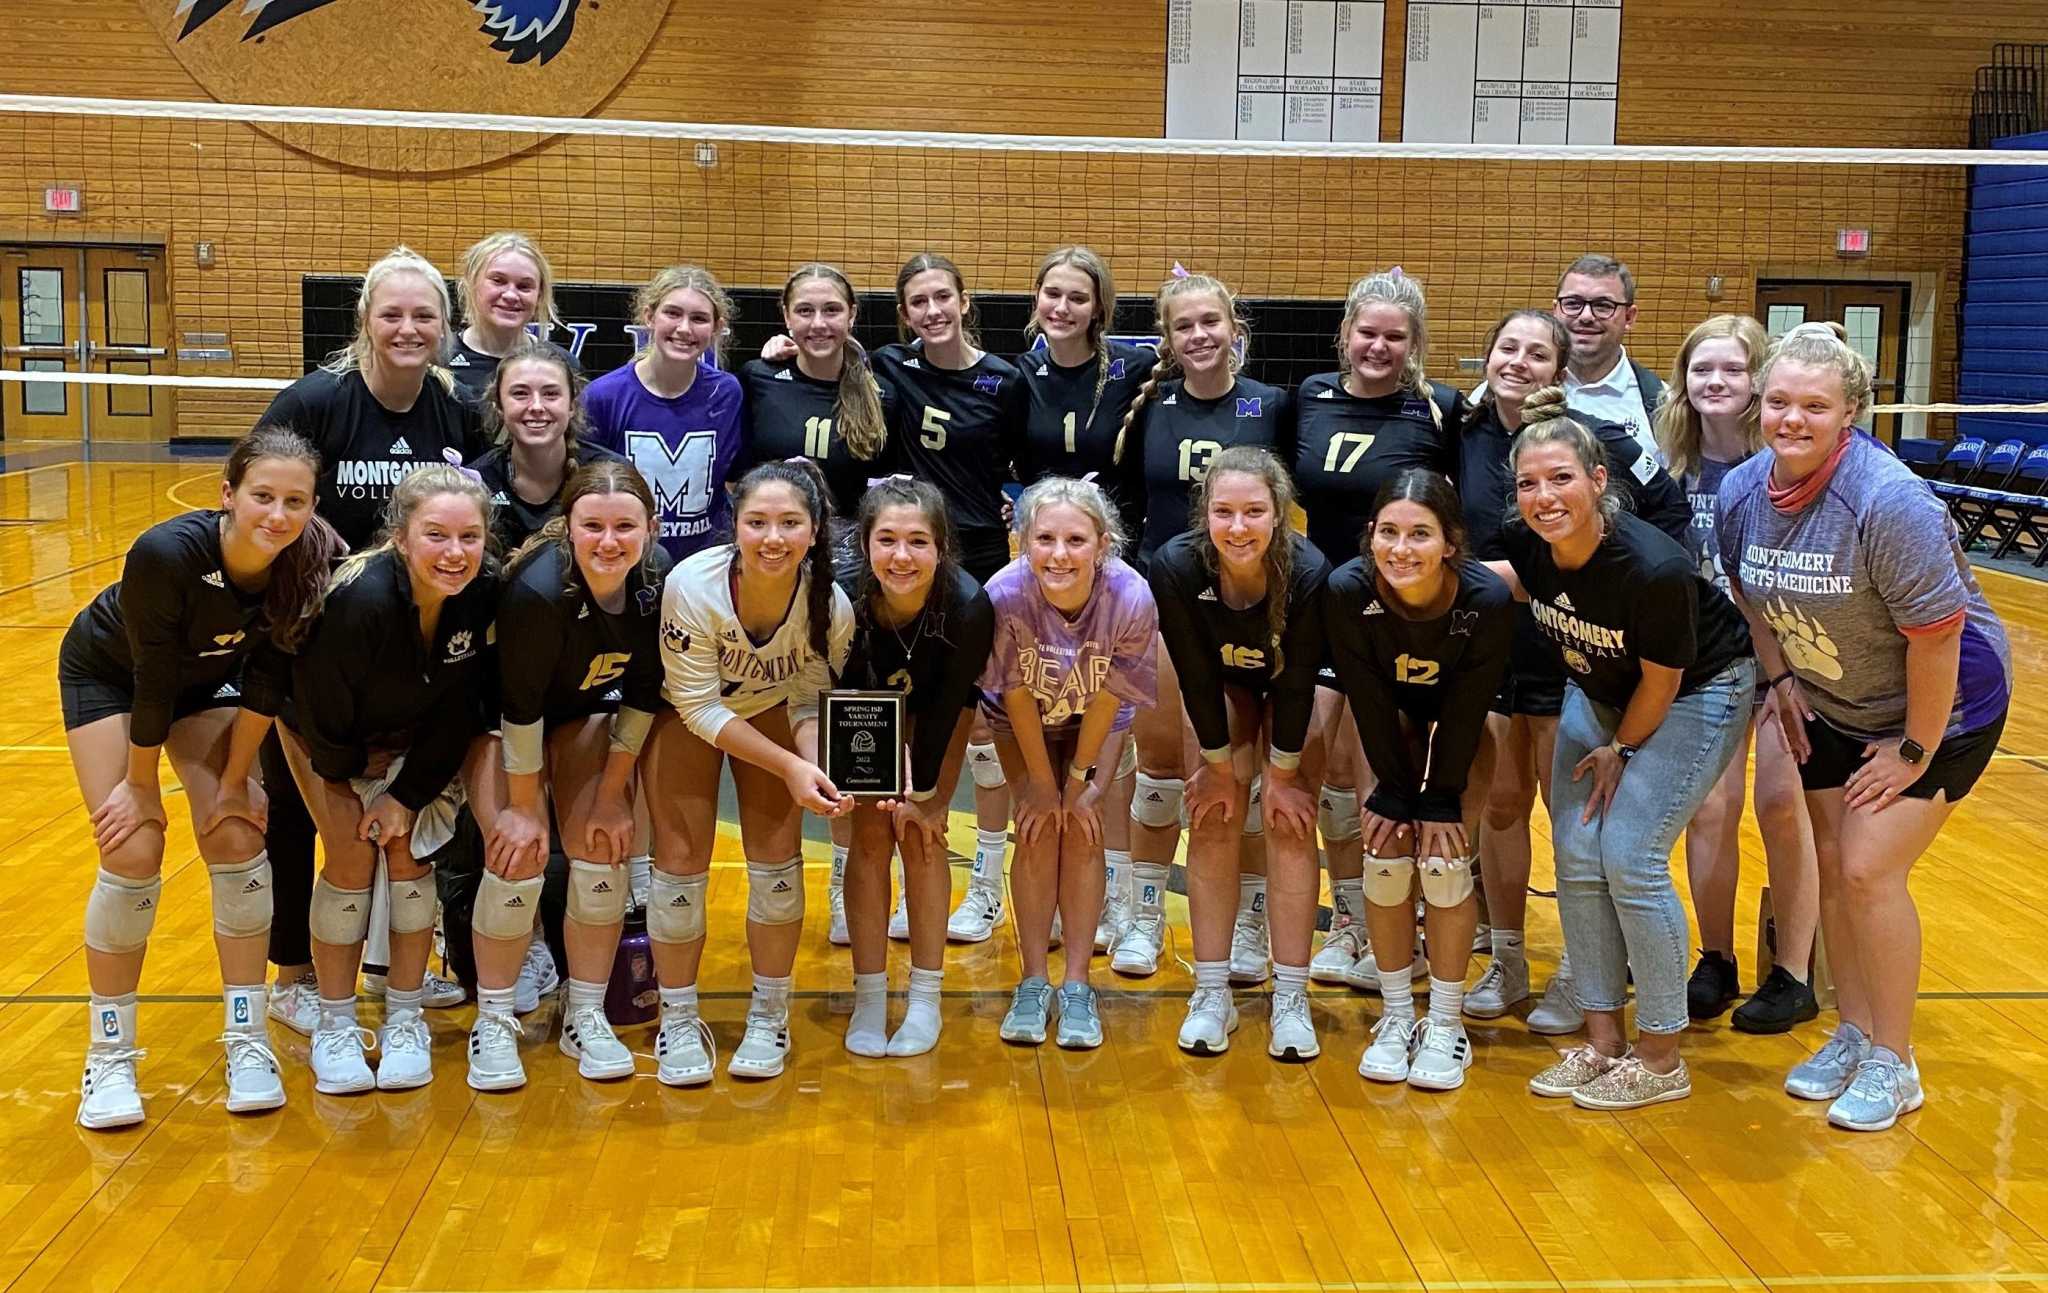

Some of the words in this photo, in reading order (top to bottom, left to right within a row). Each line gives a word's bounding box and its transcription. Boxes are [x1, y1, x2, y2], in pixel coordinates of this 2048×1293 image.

[51, 191, 72, 208] EXIT
[1235, 397, 1262, 417] M
[804, 416, 833, 459] 11
[919, 405, 951, 451] 5
[1063, 411, 1076, 453] 1
[1178, 438, 1223, 481] 13
[1323, 431, 1376, 473] 17
[624, 430, 717, 517] M
[1777, 571, 1854, 594] MEDICINE
[578, 652, 633, 690] 15
[1394, 653, 1440, 685] 12
[838, 720, 889, 728] TOURNAMENT
